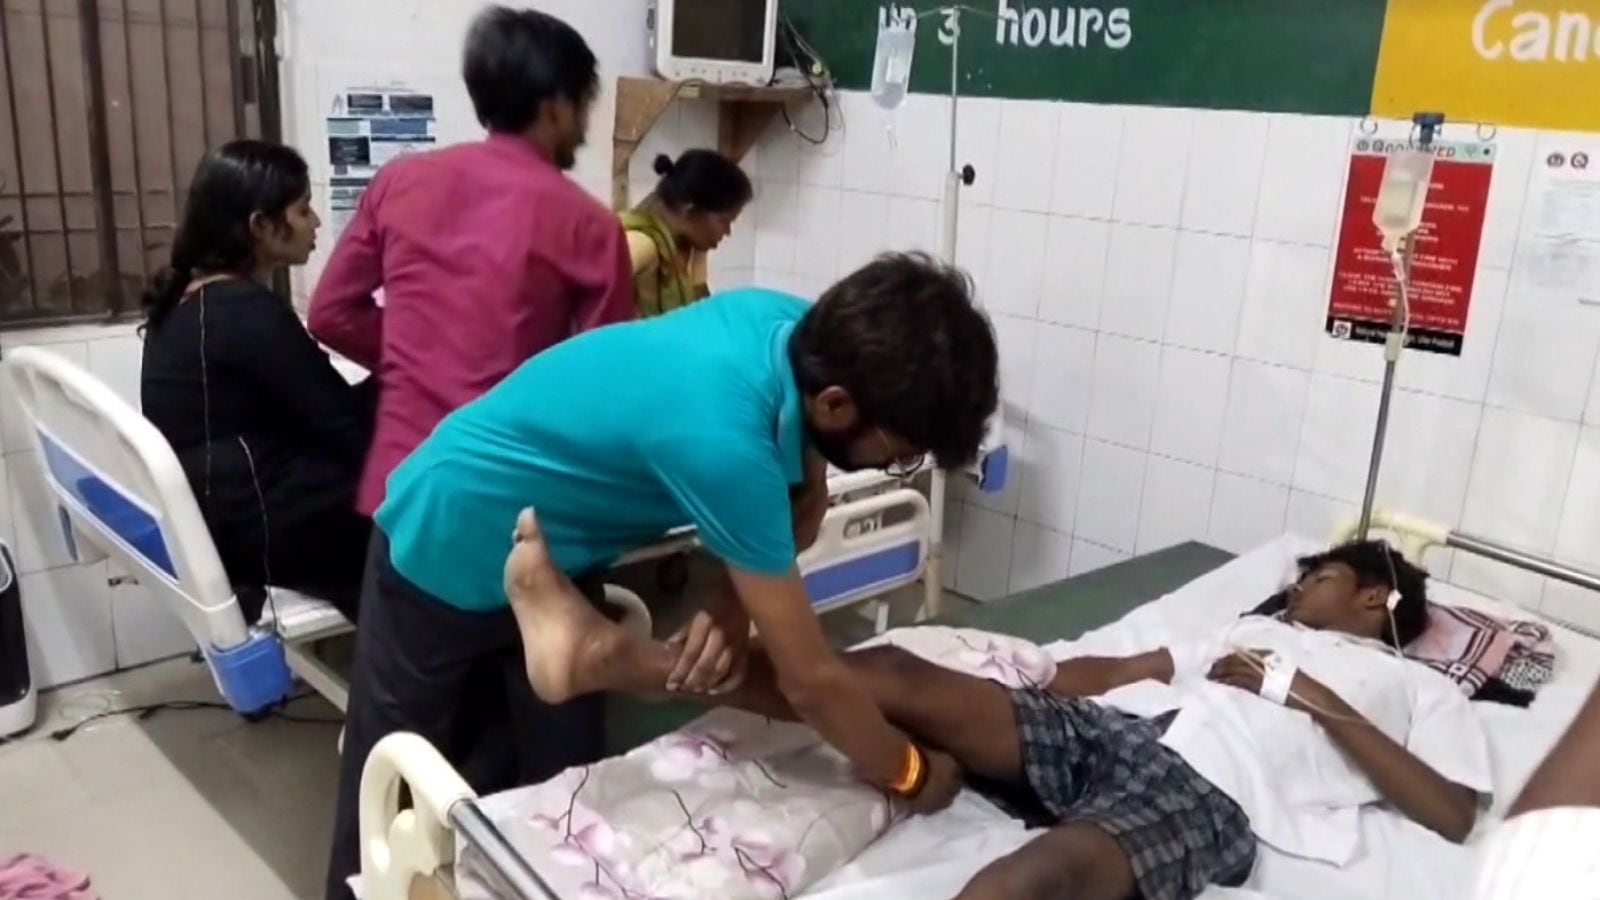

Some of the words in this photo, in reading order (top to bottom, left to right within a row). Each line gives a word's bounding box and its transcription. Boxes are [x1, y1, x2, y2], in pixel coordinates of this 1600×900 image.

[937, 7, 961, 46] 3
[995, 0, 1133, 49] hours
[1471, 0, 1600, 62] Can
